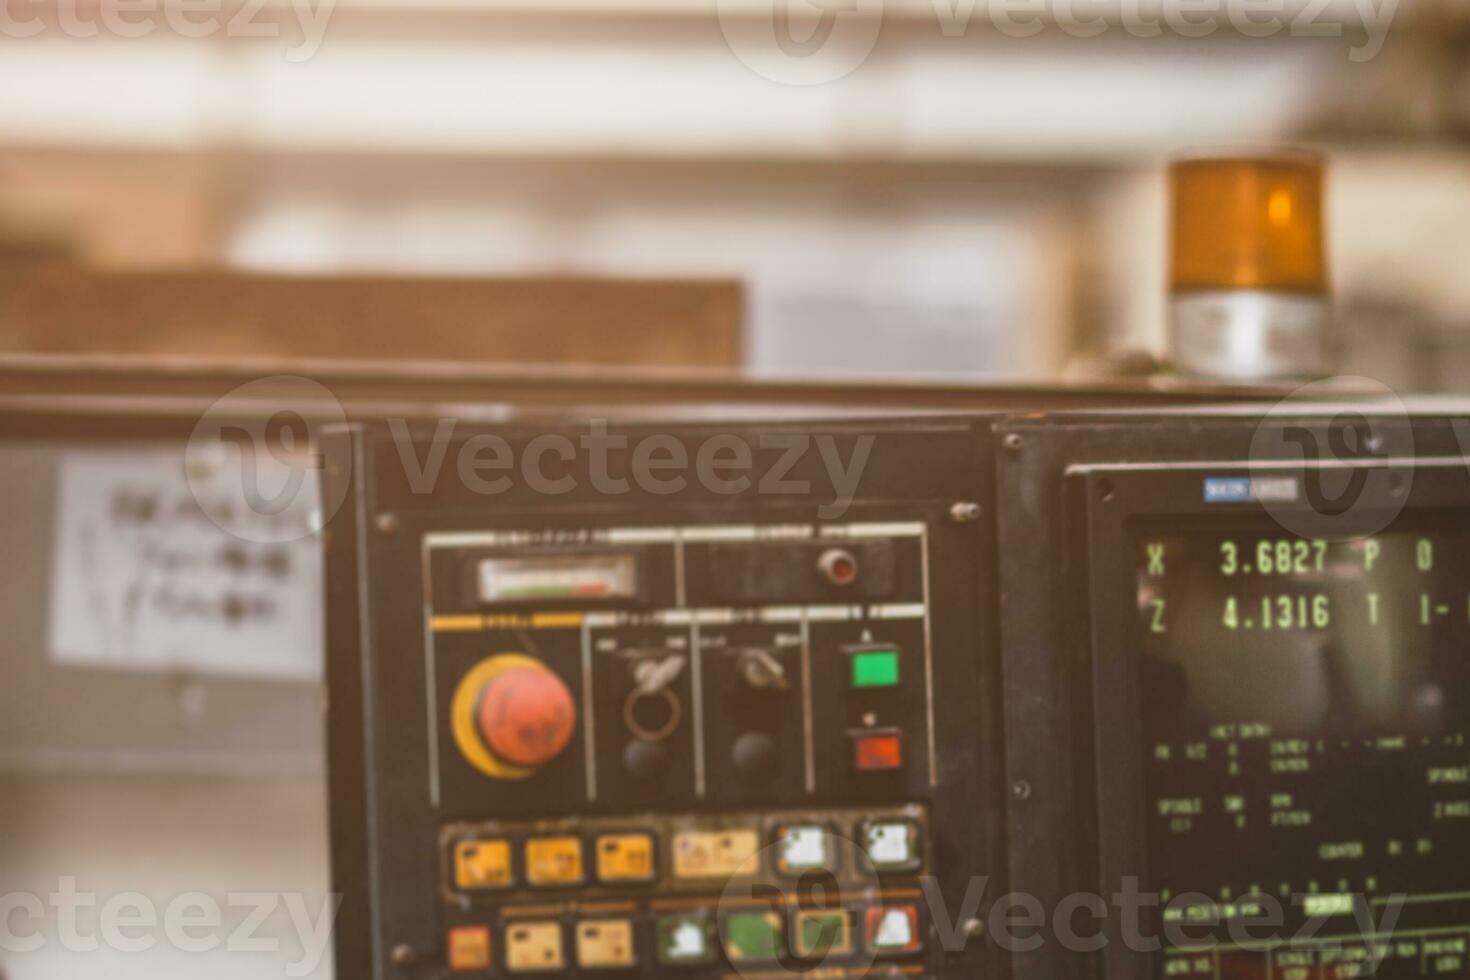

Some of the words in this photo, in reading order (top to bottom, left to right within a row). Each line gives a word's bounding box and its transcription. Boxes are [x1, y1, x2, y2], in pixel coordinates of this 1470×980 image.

[1148, 543, 1164, 574] X
[1221, 540, 1326, 575] 3.6827
[1365, 539, 1379, 571] P
[1417, 539, 1432, 571] 0
[1151, 599, 1165, 632] Z
[1224, 595, 1329, 629] 4.1316
[1367, 594, 1378, 624] T
